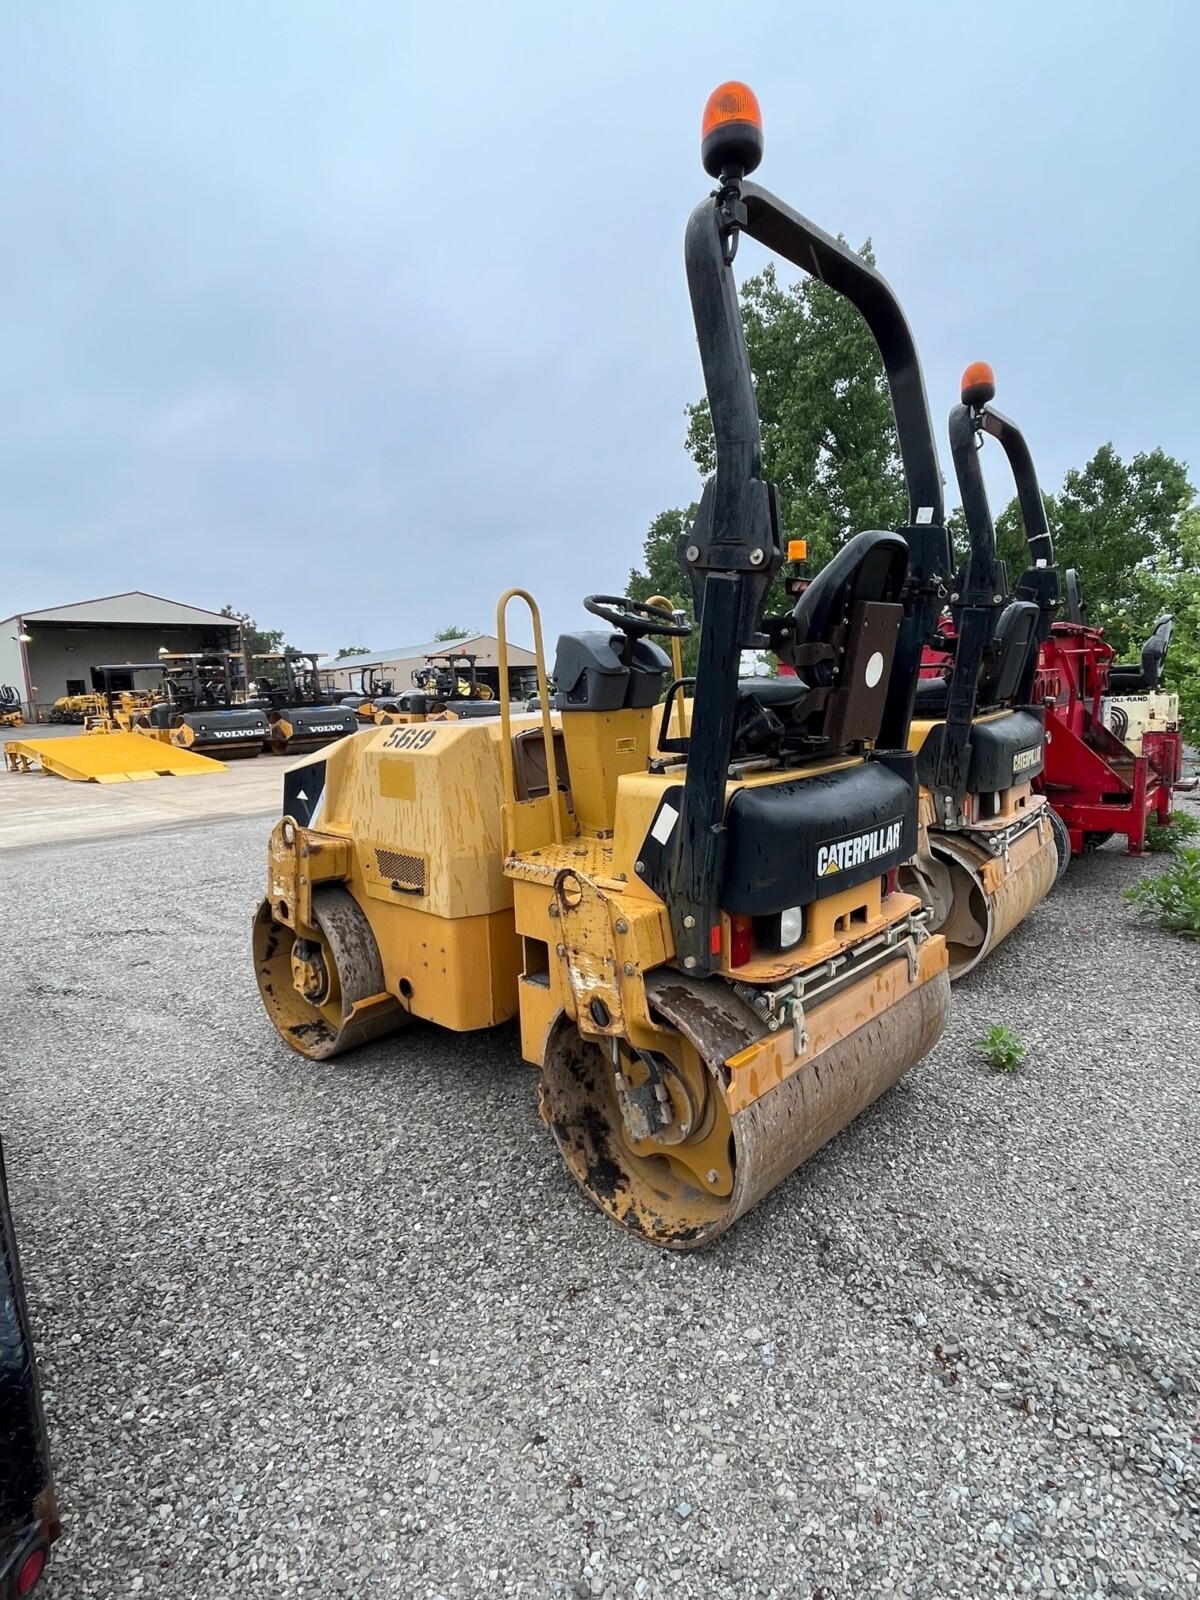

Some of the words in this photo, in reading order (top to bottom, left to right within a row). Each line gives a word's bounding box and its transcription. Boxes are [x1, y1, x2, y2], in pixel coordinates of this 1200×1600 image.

[214, 729, 254, 739] VOLVO
[309, 724, 344, 733] VOLVO
[383, 727, 437, 750] 5619
[817, 821, 902, 877] CATERPILLAR
